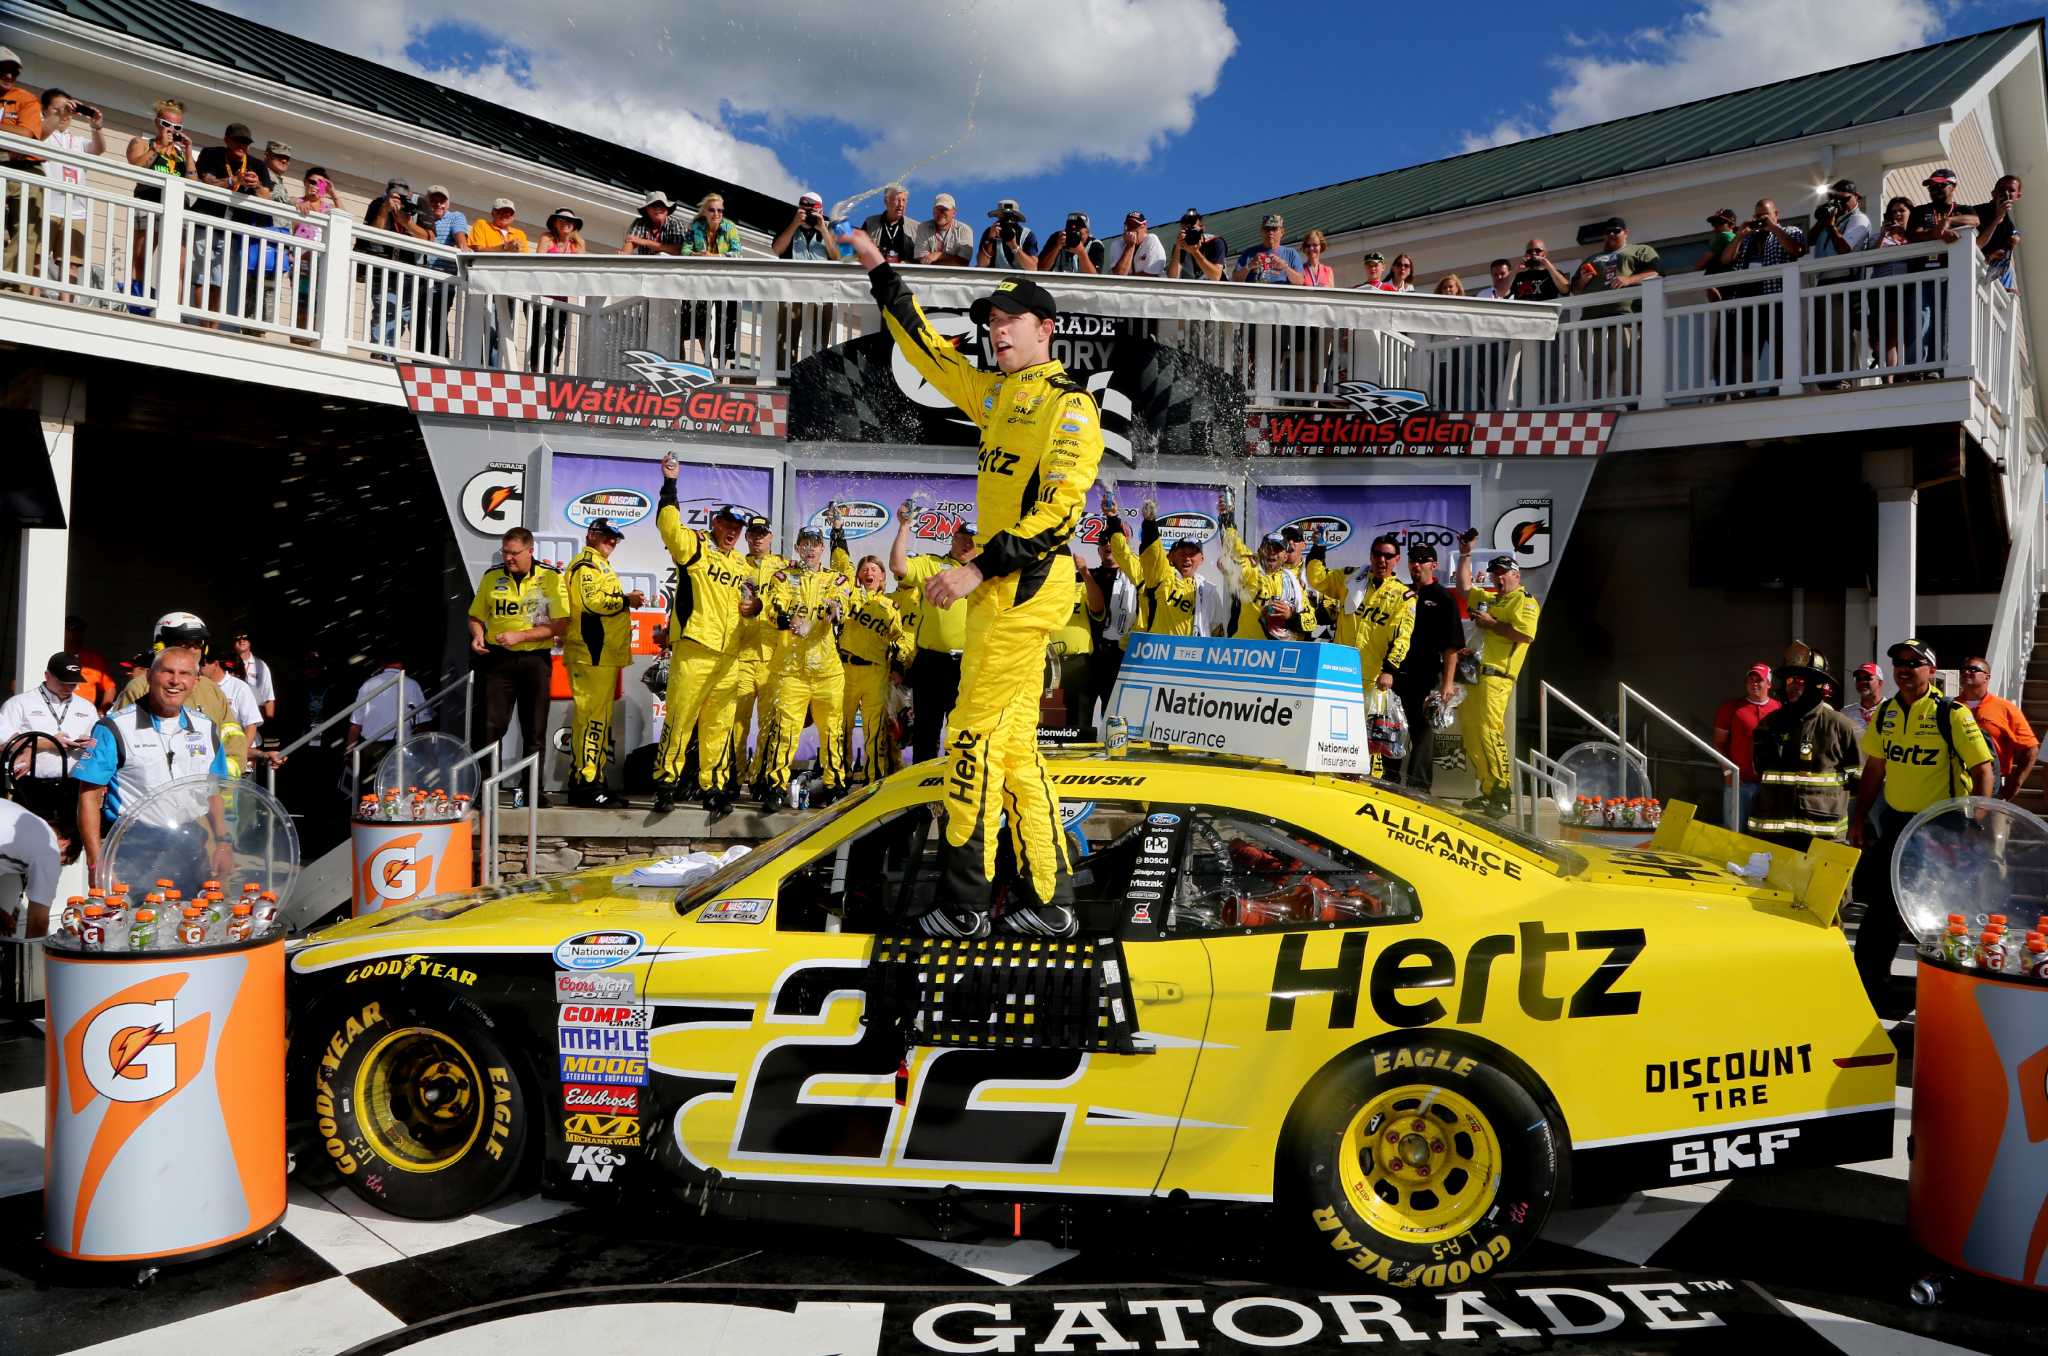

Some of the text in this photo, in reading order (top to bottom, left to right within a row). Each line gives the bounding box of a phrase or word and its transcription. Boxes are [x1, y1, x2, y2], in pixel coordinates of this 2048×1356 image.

[548, 381, 756, 422] Watkins Glen
[551, 411, 751, 432] INTERNATIONAL
[1270, 416, 1472, 443] Watkins Glen
[1274, 445, 1465, 455] INTERNATIONAL
[608, 495, 639, 505] NASCAR
[582, 506, 641, 518] Nationwide
[825, 518, 880, 528] Nionwide
[1179, 518, 1207, 527] NASCAR
[1355, 604, 1390, 626] ertz
[1131, 643, 1276, 669] JOIN THE NATION
[1155, 687, 1293, 726] Nationwide
[583, 720, 603, 762] Hertz
[1037, 728, 1080, 737] tionwide
[1150, 721, 1226, 748] Insurance
[1318, 741, 1359, 755] Nationwide
[1883, 740, 1940, 766] Hertz
[949, 729, 982, 805] Hertz
[1320, 756, 1357, 768] Insurance
[1048, 774, 1147, 787] LOWSKI
[1151, 814, 1174, 825] Ford
[1145, 838, 1168, 851] PPG
[1354, 802, 1521, 881] ALLIANCE
[1144, 857, 1169, 865] BOSCH
[1385, 827, 1489, 877] TRUCK PARTS
[1130, 879, 1163, 888] Mazak
[729, 902, 760, 912] NASCAR
[598, 936, 630, 945] NASCAR
[571, 946, 630, 956] Nationwide
[558, 976, 633, 992] Coors LIGHT
[1266, 921, 1647, 1031] Hertz
[569, 991, 622, 999] POLE
[563, 1007, 632, 1022] COMP
[560, 1028, 649, 1052] MAHLE
[563, 1056, 645, 1075] MOOG
[1373, 1048, 1478, 1078] EAGLE
[1645, 1043, 1812, 1093] DISCOUNT
[565, 1087, 637, 1108] Edelbrock
[1692, 1084, 1768, 1112] TIRE
[484, 1067, 513, 1161] EAGLE
[566, 1133, 641, 1146] MECHANIX WEAR
[1669, 1127, 1800, 1178] SKF
[912, 1283, 1727, 1353] GATORADE
